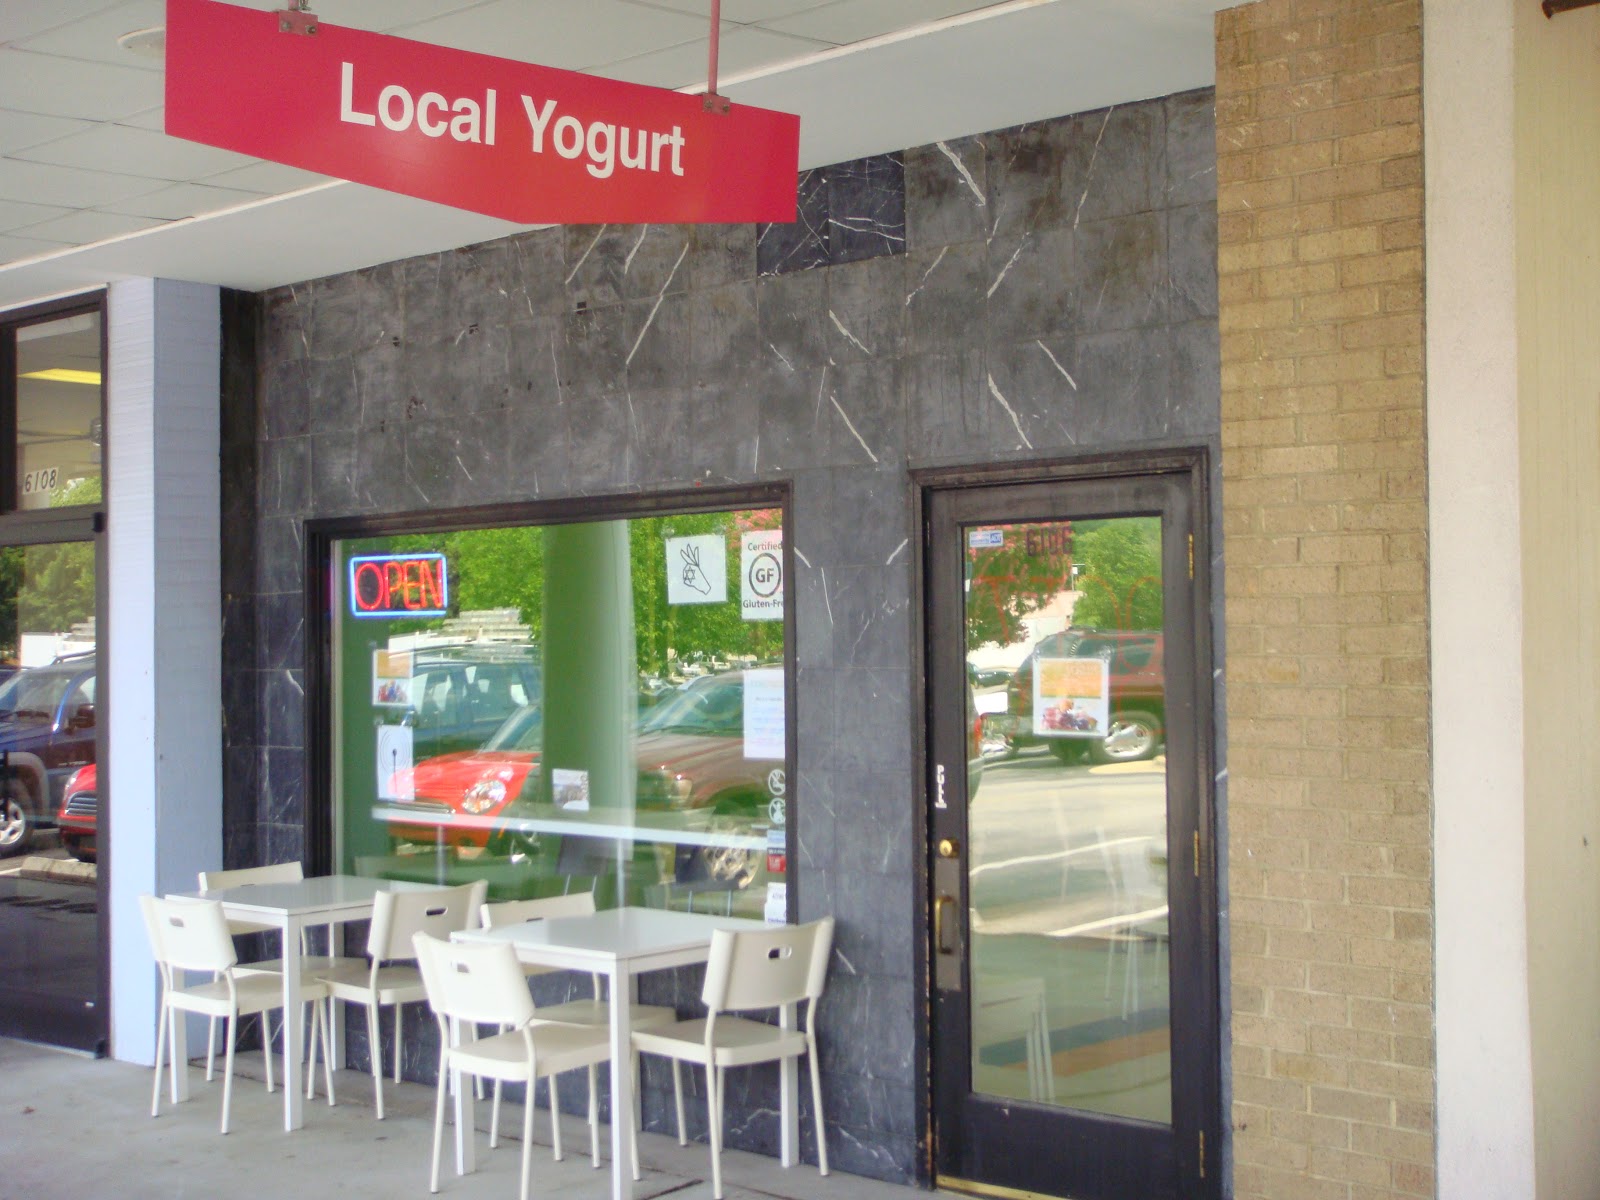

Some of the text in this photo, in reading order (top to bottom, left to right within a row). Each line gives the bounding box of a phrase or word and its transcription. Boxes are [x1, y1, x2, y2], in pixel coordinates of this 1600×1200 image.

[341, 62, 685, 179] Local Yogurt
[25, 468, 57, 492] 6108
[355, 560, 443, 611] OPEN
[755, 567, 775, 583] GF
